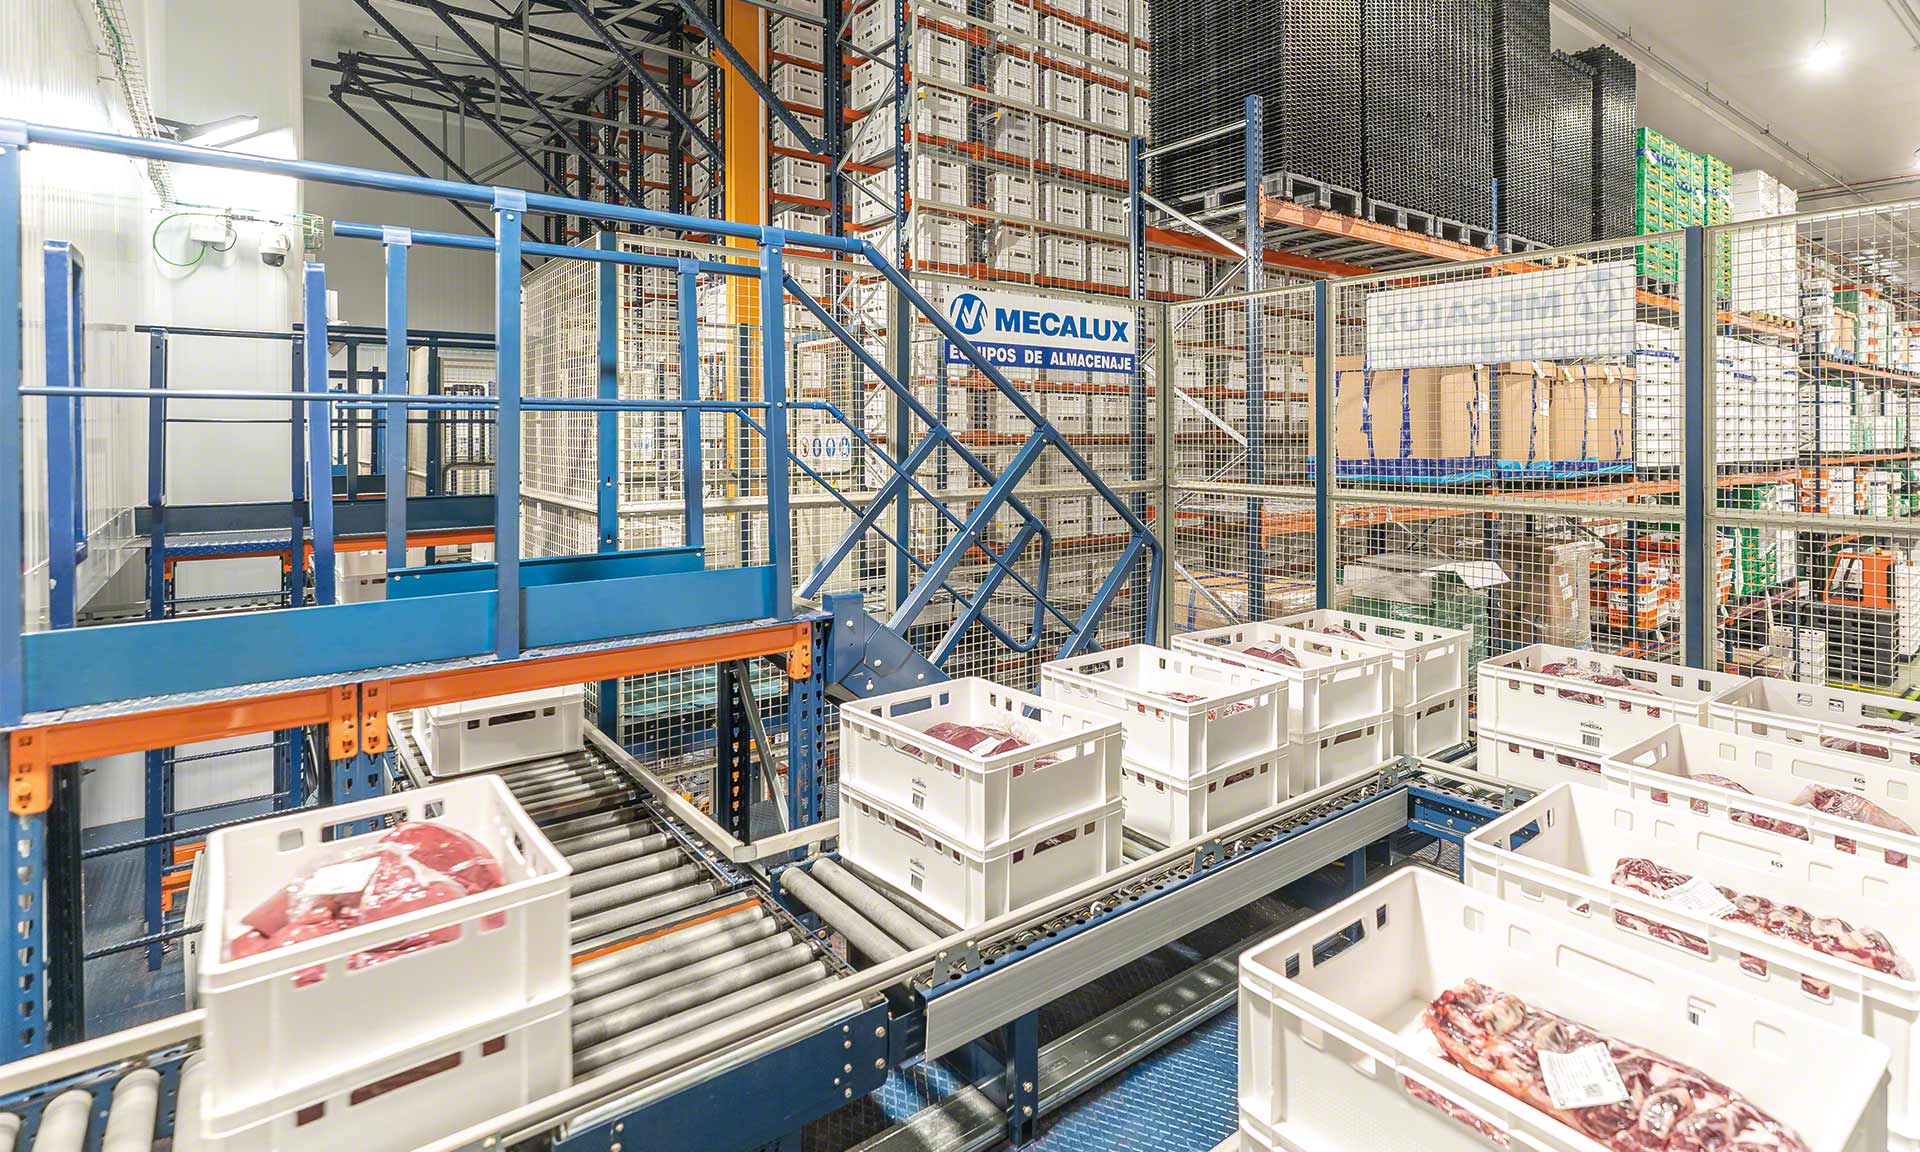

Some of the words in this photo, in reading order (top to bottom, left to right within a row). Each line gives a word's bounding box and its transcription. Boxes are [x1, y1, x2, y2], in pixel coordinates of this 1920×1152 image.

[995, 308, 1128, 342] MECALUX
[950, 344, 1016, 363] EIPOS
[1024, 350, 1043, 364] DE
[1050, 351, 1132, 370] ALMACENAJE
